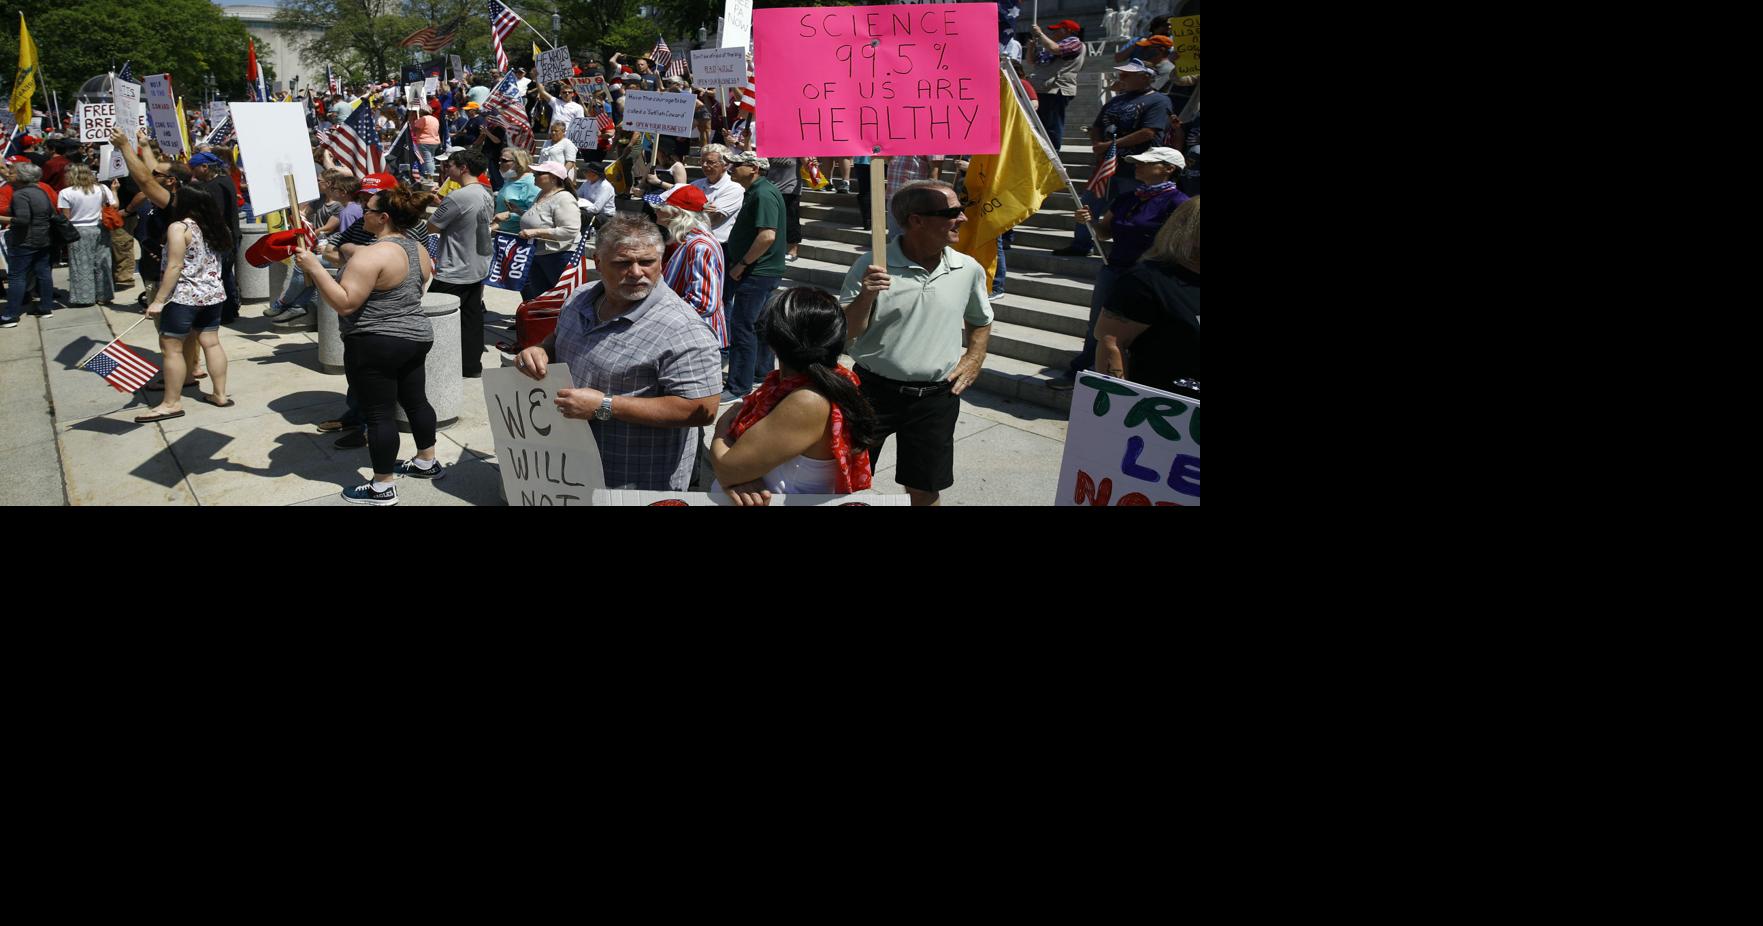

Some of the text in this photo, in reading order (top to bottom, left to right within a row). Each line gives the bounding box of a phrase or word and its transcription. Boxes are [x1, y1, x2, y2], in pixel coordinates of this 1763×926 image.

[728, 12, 748, 32] NOW
[799, 10, 959, 38] SCIENCE
[802, 78, 976, 101] OF US ARE
[84, 104, 116, 118] FREE
[570, 117, 597, 129] FACT
[798, 104, 979, 142] HEALTHY
[567, 129, 593, 141] WOLF
[494, 387, 552, 440] WE
[507, 446, 585, 487] WILL
